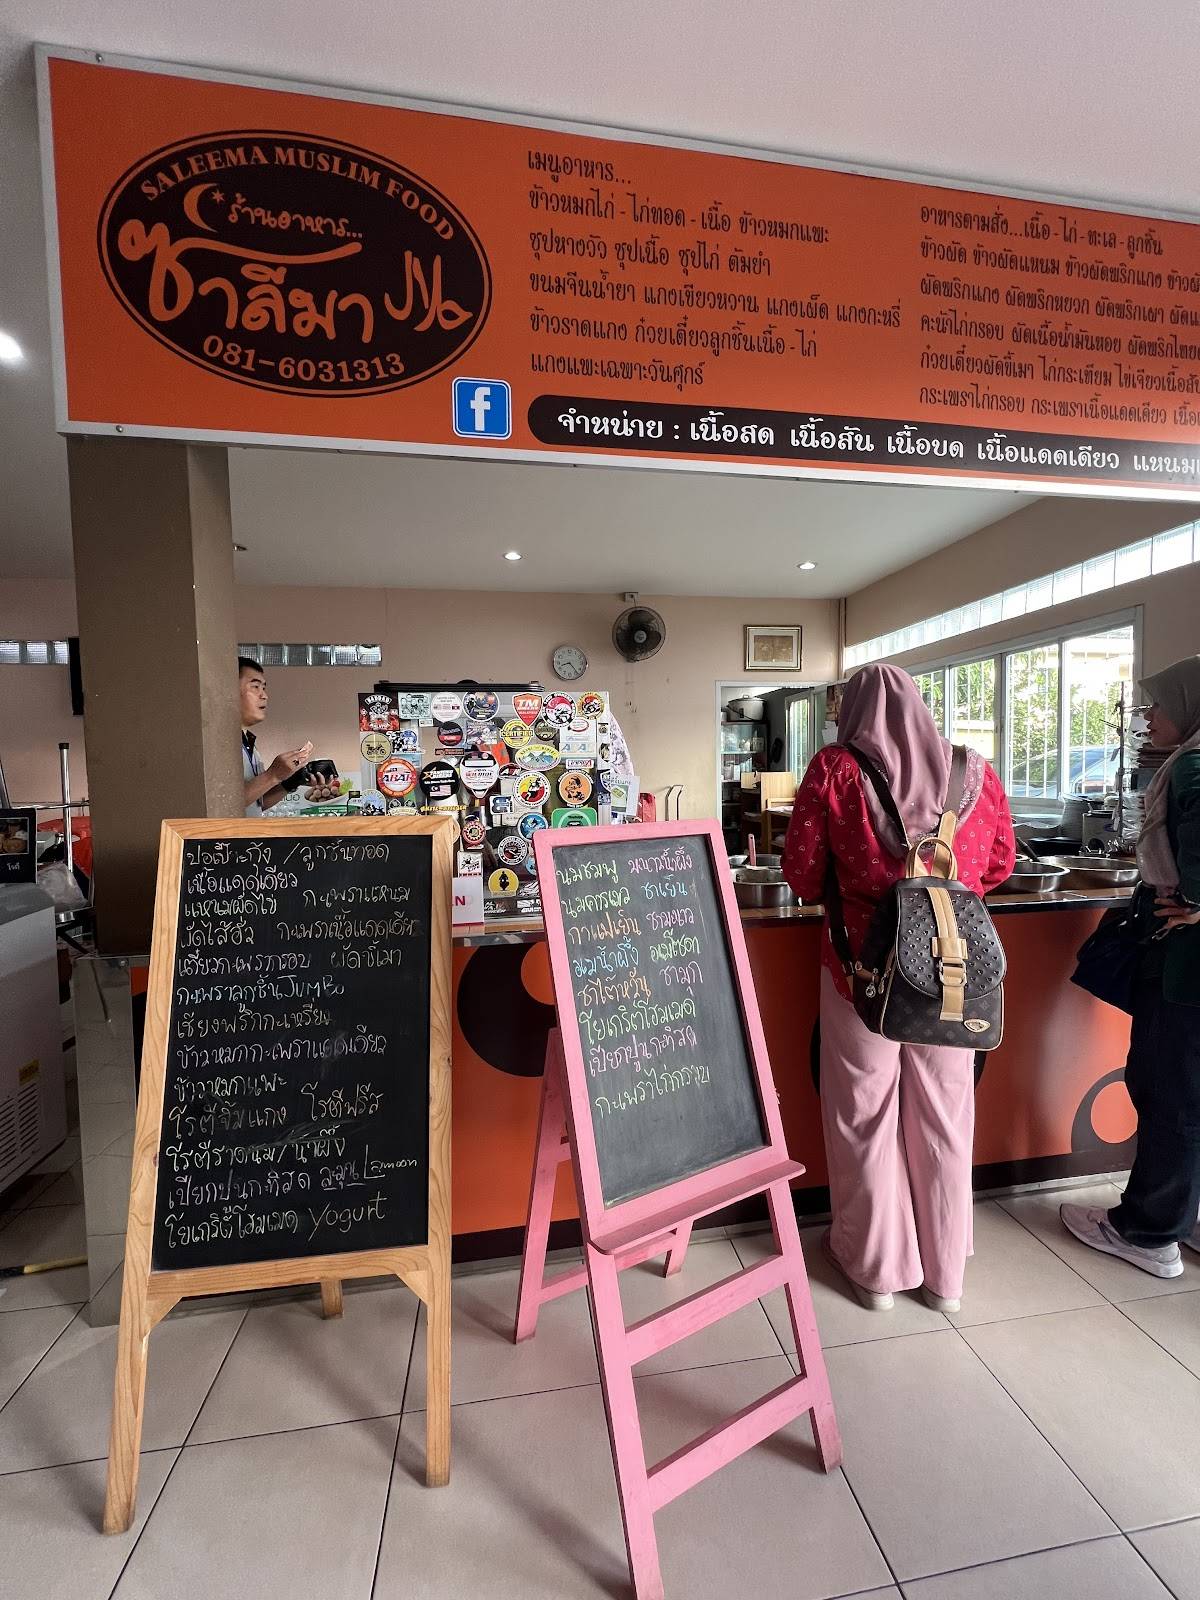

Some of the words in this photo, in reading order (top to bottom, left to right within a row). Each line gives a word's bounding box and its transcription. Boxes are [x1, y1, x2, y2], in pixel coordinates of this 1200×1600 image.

[141, 146, 269, 200] SALEEMA
[274, 146, 381, 190] MUSLIM
[385, 177, 454, 239] FOOD
[529, 186, 615, 220] ข้าวหมกไก่
[627, 192, 686, 228] ไก่ทอด
[701, 201, 731, 232] เนื้อ
[739, 210, 829, 243] ข้าวหมกแพะ
[728, 247, 771, 276] ต้มยำ
[920, 236, 967, 264] ข้าวผัด
[973, 243, 1060, 274] ข้าวผัดแหนม
[1065, 254, 1162, 288] ข้าวผัดพริกแกง
[1059, 216, 1077, 243] ไก่
[1088, 229, 1117, 249] ทะเล
[1127, 228, 1163, 259] ลูกชิ้น
[530, 269, 635, 303] ขนมจีนน้ำยา
[644, 278, 759, 313] แกงเขียวหวาน
[767, 294, 829, 320] แกงเผ็ด
[837, 298, 901, 328] แกงกะหรี่
[920, 273, 1000, 304] ผัดพริกแกง
[1006, 284, 1089, 315] ผัดพริกหยวก
[530, 305, 627, 341] ข้าวราดแกง
[795, 329, 817, 357] ไก่
[920, 308, 1004, 341] คะน้าไก่กรอบ
[1012, 319, 1121, 353] ผัดเนื้อน้ำมันหอย
[202, 334, 405, 383] 081-6031313
[1040, 355, 1112, 386] ไก่กระเทียม
[920, 383, 1024, 413] กระเพราไก่กรอบ
[1031, 393, 1167, 424] กระเพราเนื้อแดดเดียว
[690, 410, 774, 446] เนื้อสด
[790, 417, 875, 452] เนื้อสัน
[887, 425, 964, 458] เนื้อบด
[977, 433, 1120, 469] เนื้อแดดเดียว
